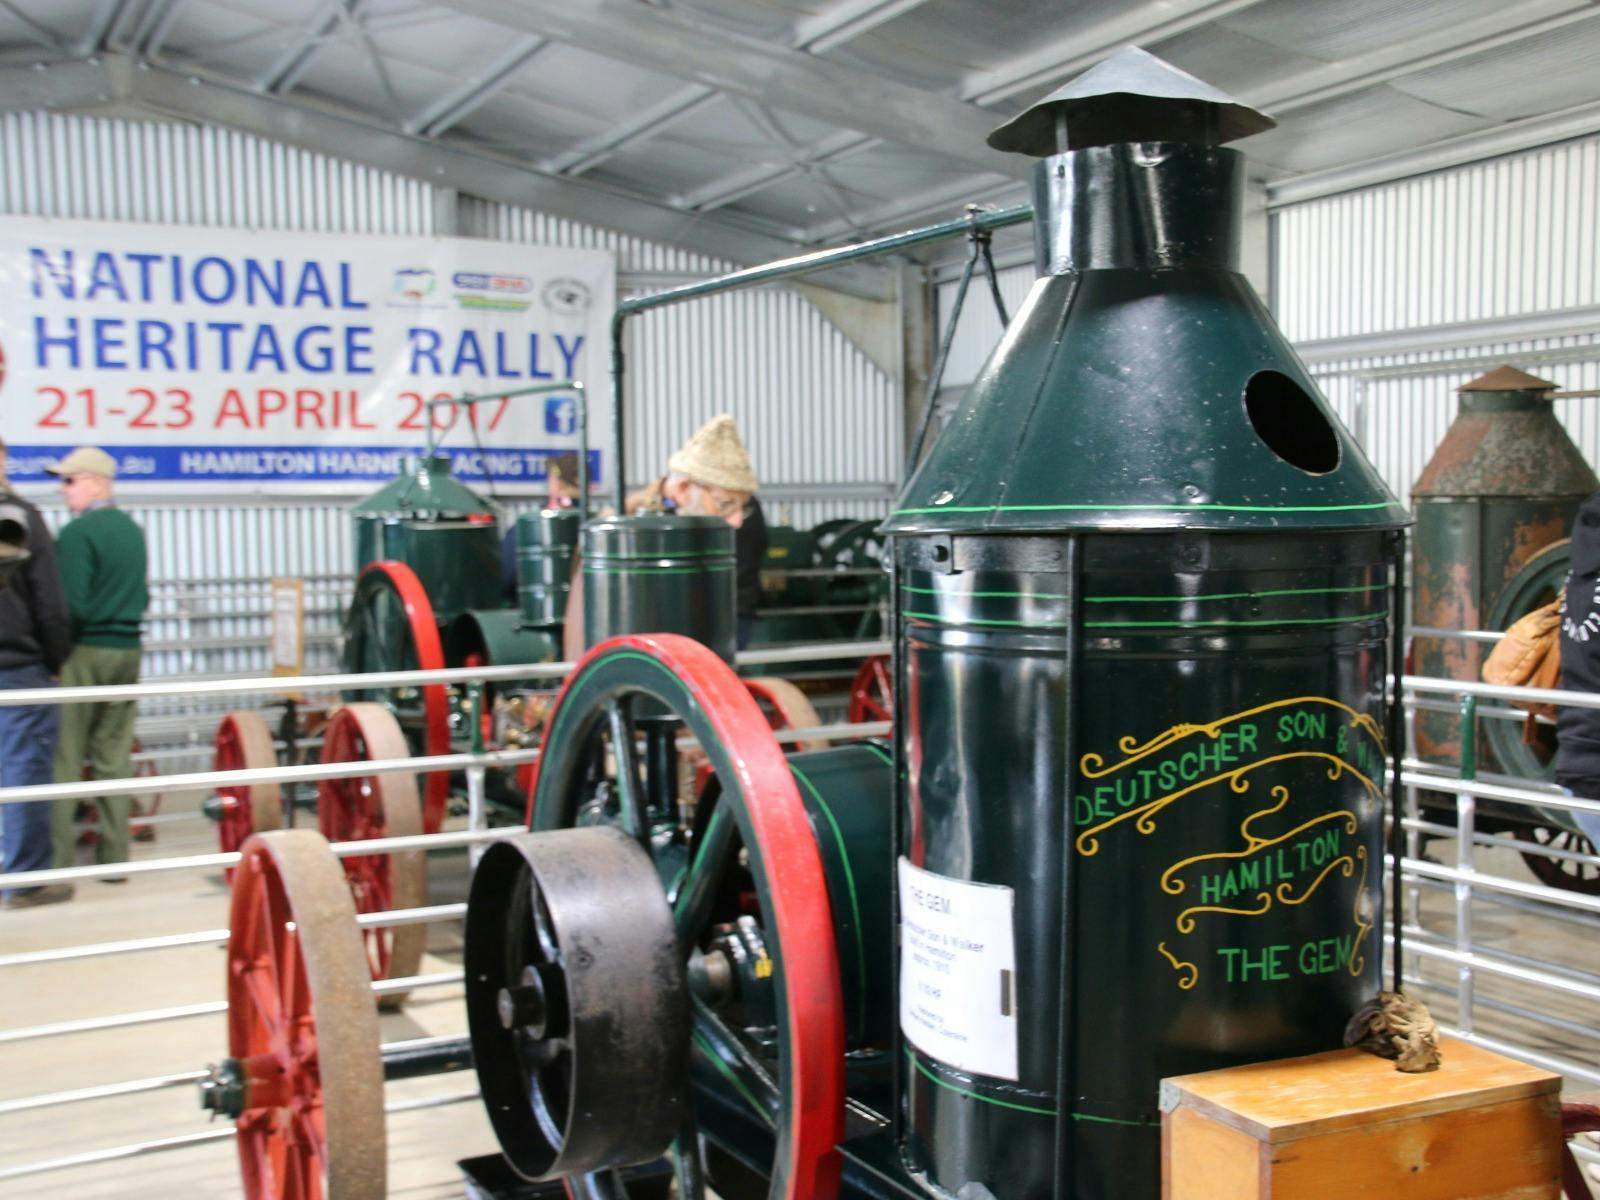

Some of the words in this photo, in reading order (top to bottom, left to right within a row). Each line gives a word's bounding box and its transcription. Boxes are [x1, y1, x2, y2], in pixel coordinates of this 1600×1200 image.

[29, 247, 368, 310] NATIONAL
[34, 316, 375, 375] HERITAGE
[407, 327, 585, 380] RALLY
[36, 386, 194, 429] 21-23
[214, 388, 378, 431] APRIL
[397, 391, 511, 431] 2017
[180, 450, 315, 474] HAMILTON
[437, 452, 522, 475] ACING
[1074, 723, 1258, 826] DEUTSCHER
[1276, 711, 1327, 743] SON
[1200, 829, 1340, 904] HAMILTON
[1217, 944, 1290, 983] THE
[1299, 934, 1352, 976] GEM
